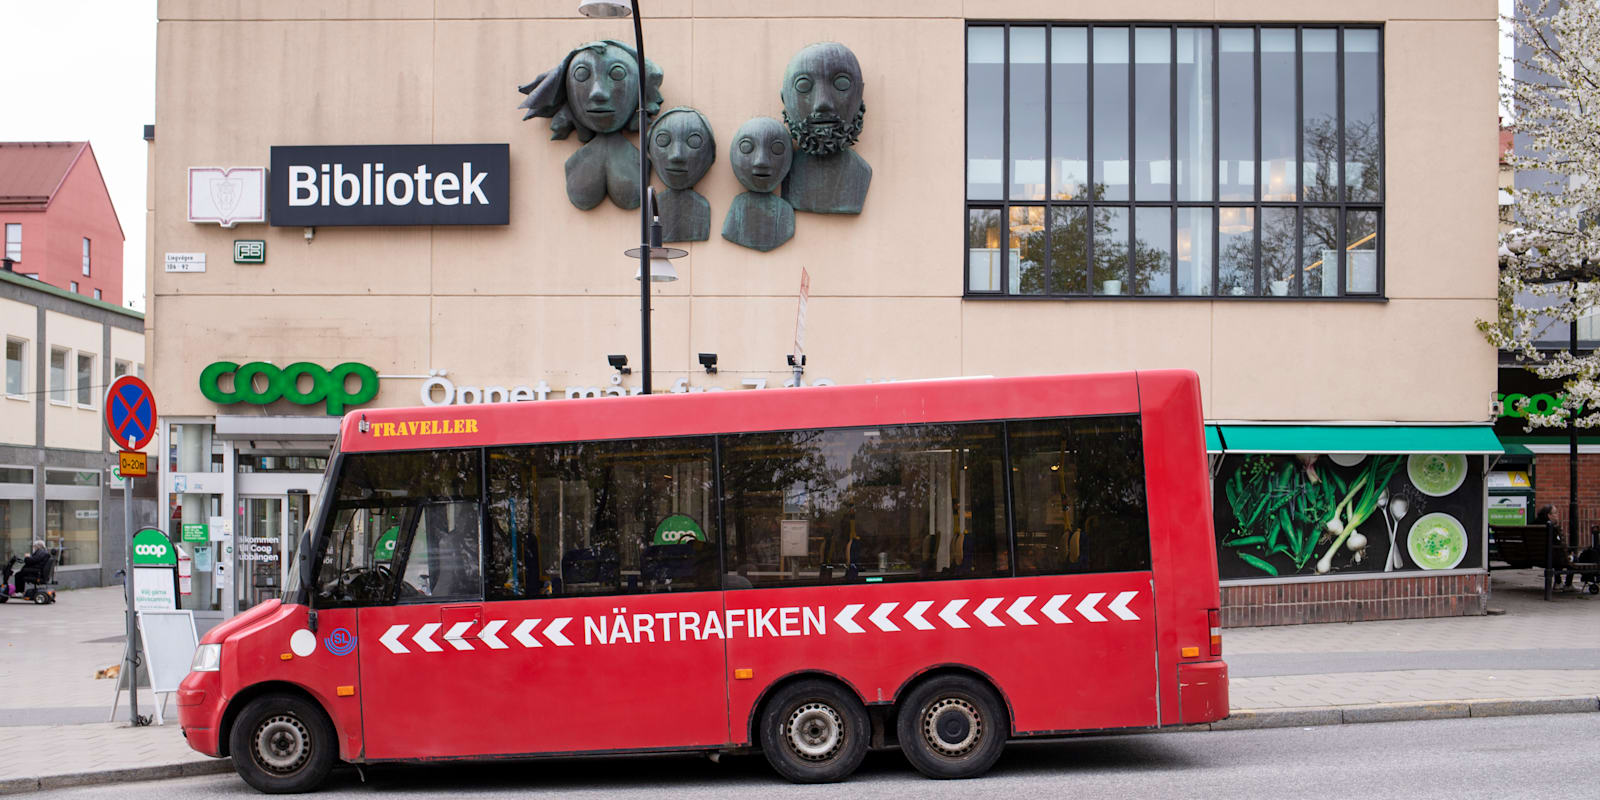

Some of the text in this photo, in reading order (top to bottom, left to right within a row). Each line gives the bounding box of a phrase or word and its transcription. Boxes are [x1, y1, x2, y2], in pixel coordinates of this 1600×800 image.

[288, 162, 490, 207] Bibliotek
[200, 361, 380, 416] coop
[420, 368, 551, 407] Öppet
[371, 419, 479, 437] TRAVELLER
[238, 536, 279, 544] lkommen
[250, 544, 272, 554] Coop
[135, 544, 167, 558] coop
[583, 605, 827, 645] NÄRTRAFIKEN
[334, 632, 349, 644] SL
